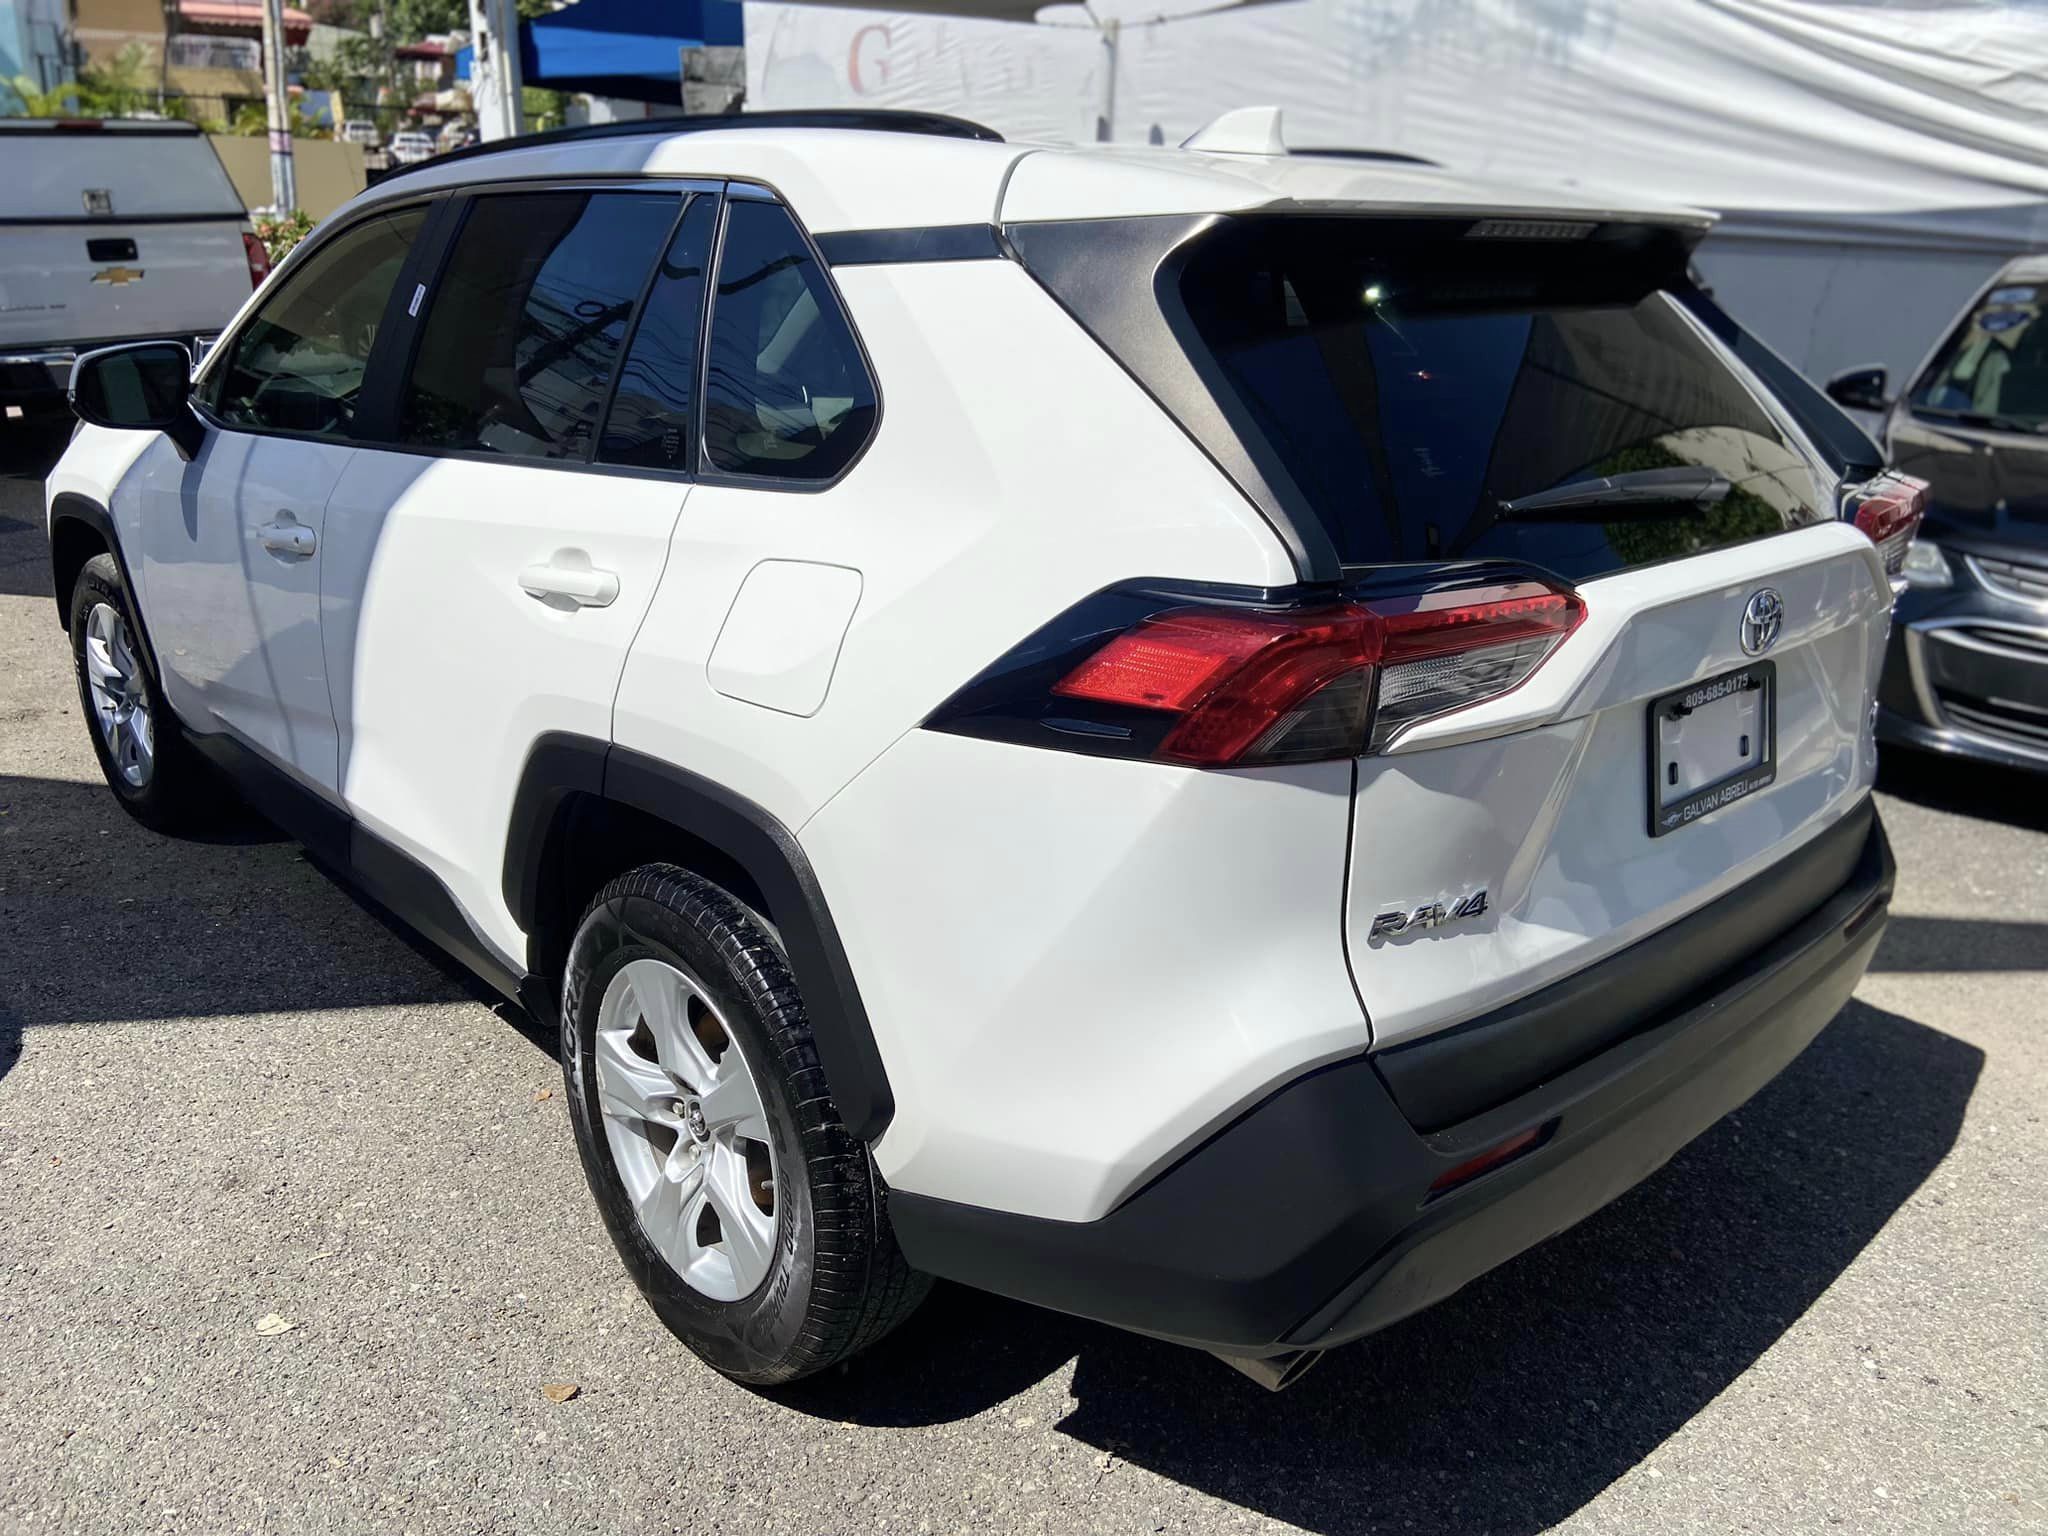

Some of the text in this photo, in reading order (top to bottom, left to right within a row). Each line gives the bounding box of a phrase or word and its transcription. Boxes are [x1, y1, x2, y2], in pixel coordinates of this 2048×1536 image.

[1685, 673, 1749, 708] 809-685-0175
[1683, 793, 1719, 821] GALVAN
[1719, 780, 1748, 804] ABREU
[1367, 886, 1489, 941] RAV4
